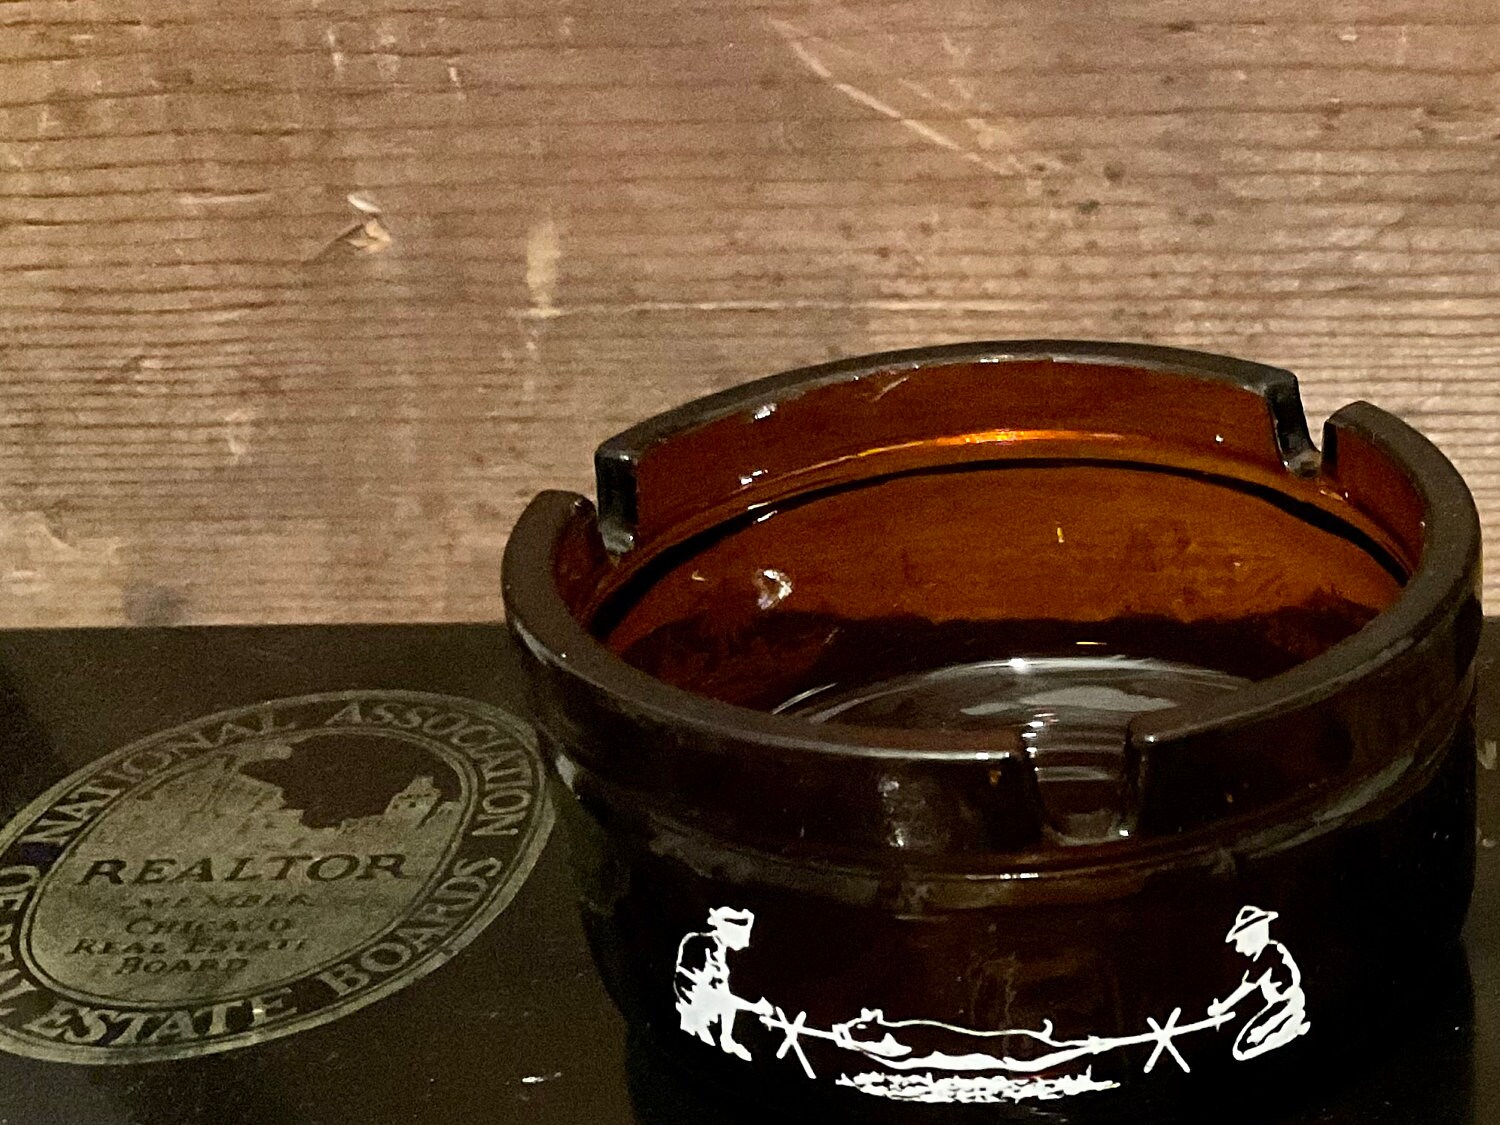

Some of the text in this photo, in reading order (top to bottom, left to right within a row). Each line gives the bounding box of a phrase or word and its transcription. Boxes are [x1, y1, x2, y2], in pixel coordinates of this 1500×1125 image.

[18, 701, 533, 847] NATIONAL ASSOCIATION
[75, 854, 413, 887] REALTOR
[22, 987, 299, 1044] ESTATE
[317, 856, 503, 999] BOARDS
